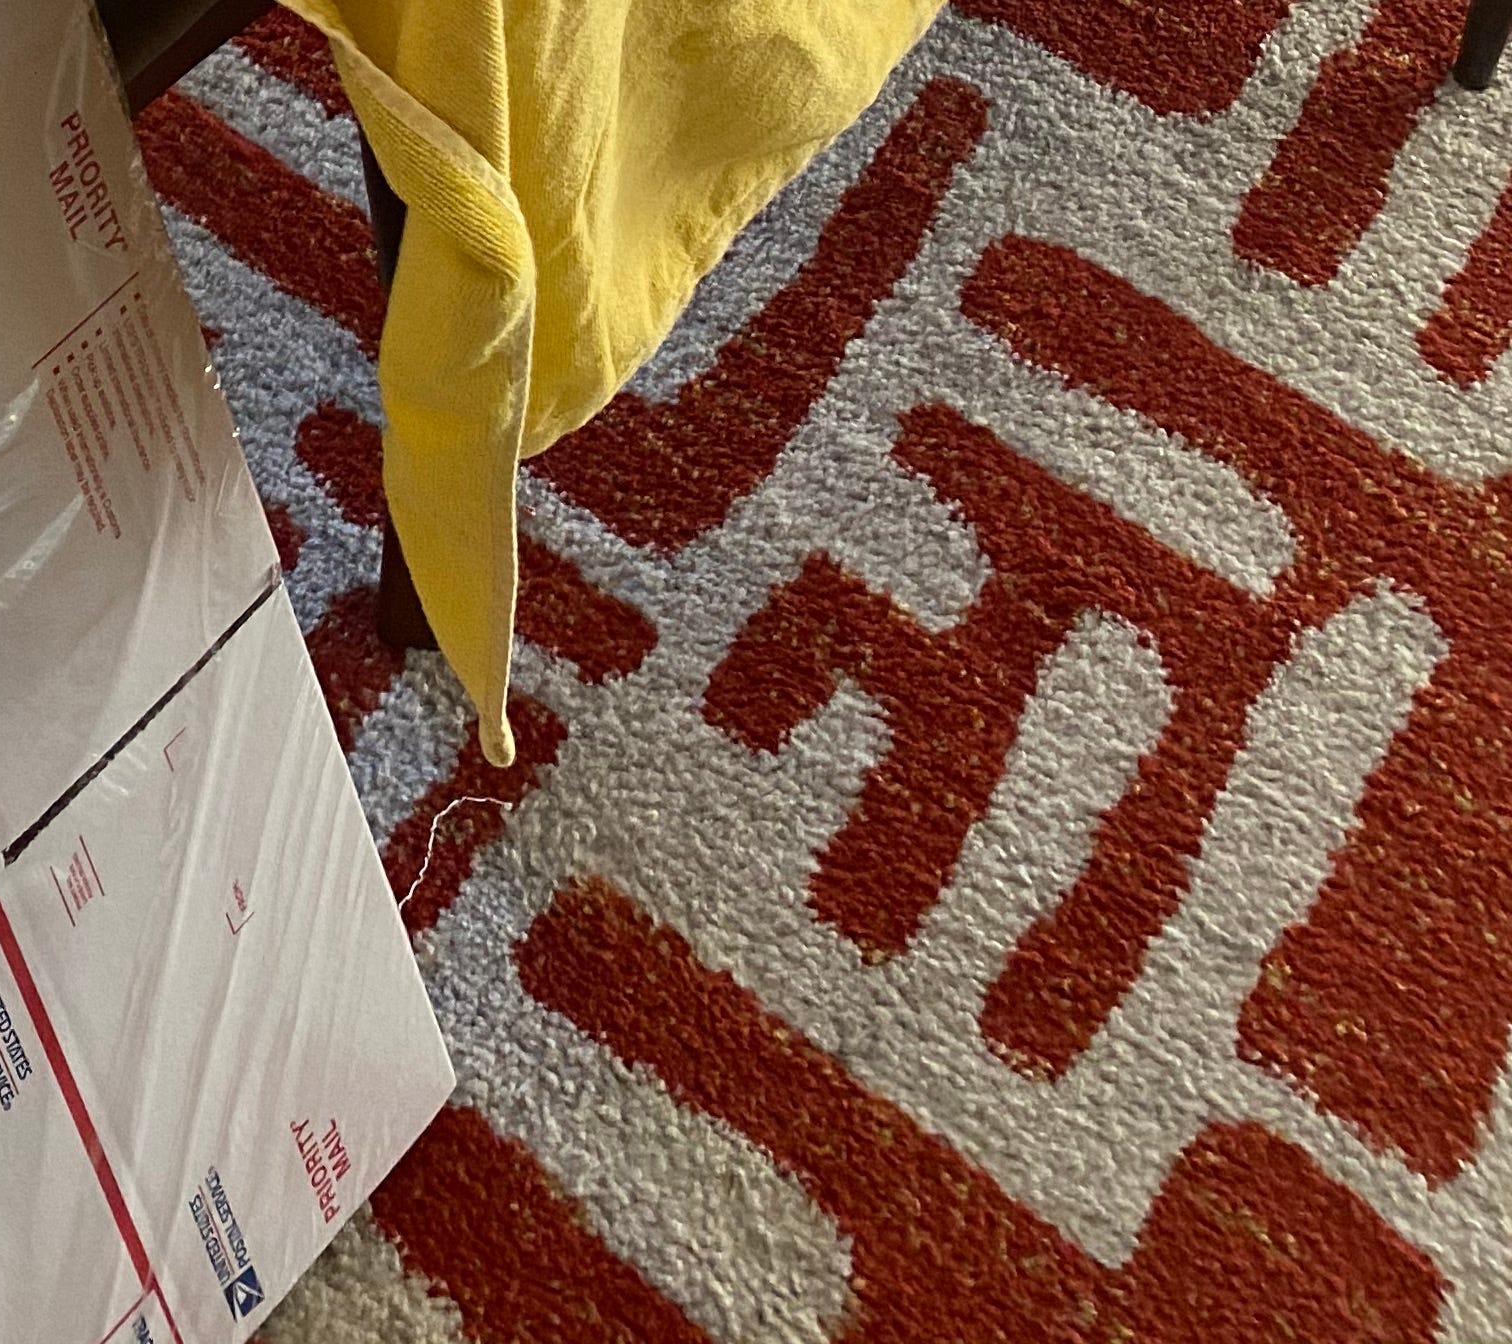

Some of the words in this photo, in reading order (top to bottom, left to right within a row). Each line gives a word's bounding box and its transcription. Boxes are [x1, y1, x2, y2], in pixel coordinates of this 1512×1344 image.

[49, 161, 89, 241] MAIL
[3, 1029, 32, 1080] STATES
[321, 1119, 351, 1173] MAIL
[189, 1193, 211, 1240] STATES
[205, 1232, 230, 1286] UNITED
[227, 1219, 250, 1267] POSTAL
